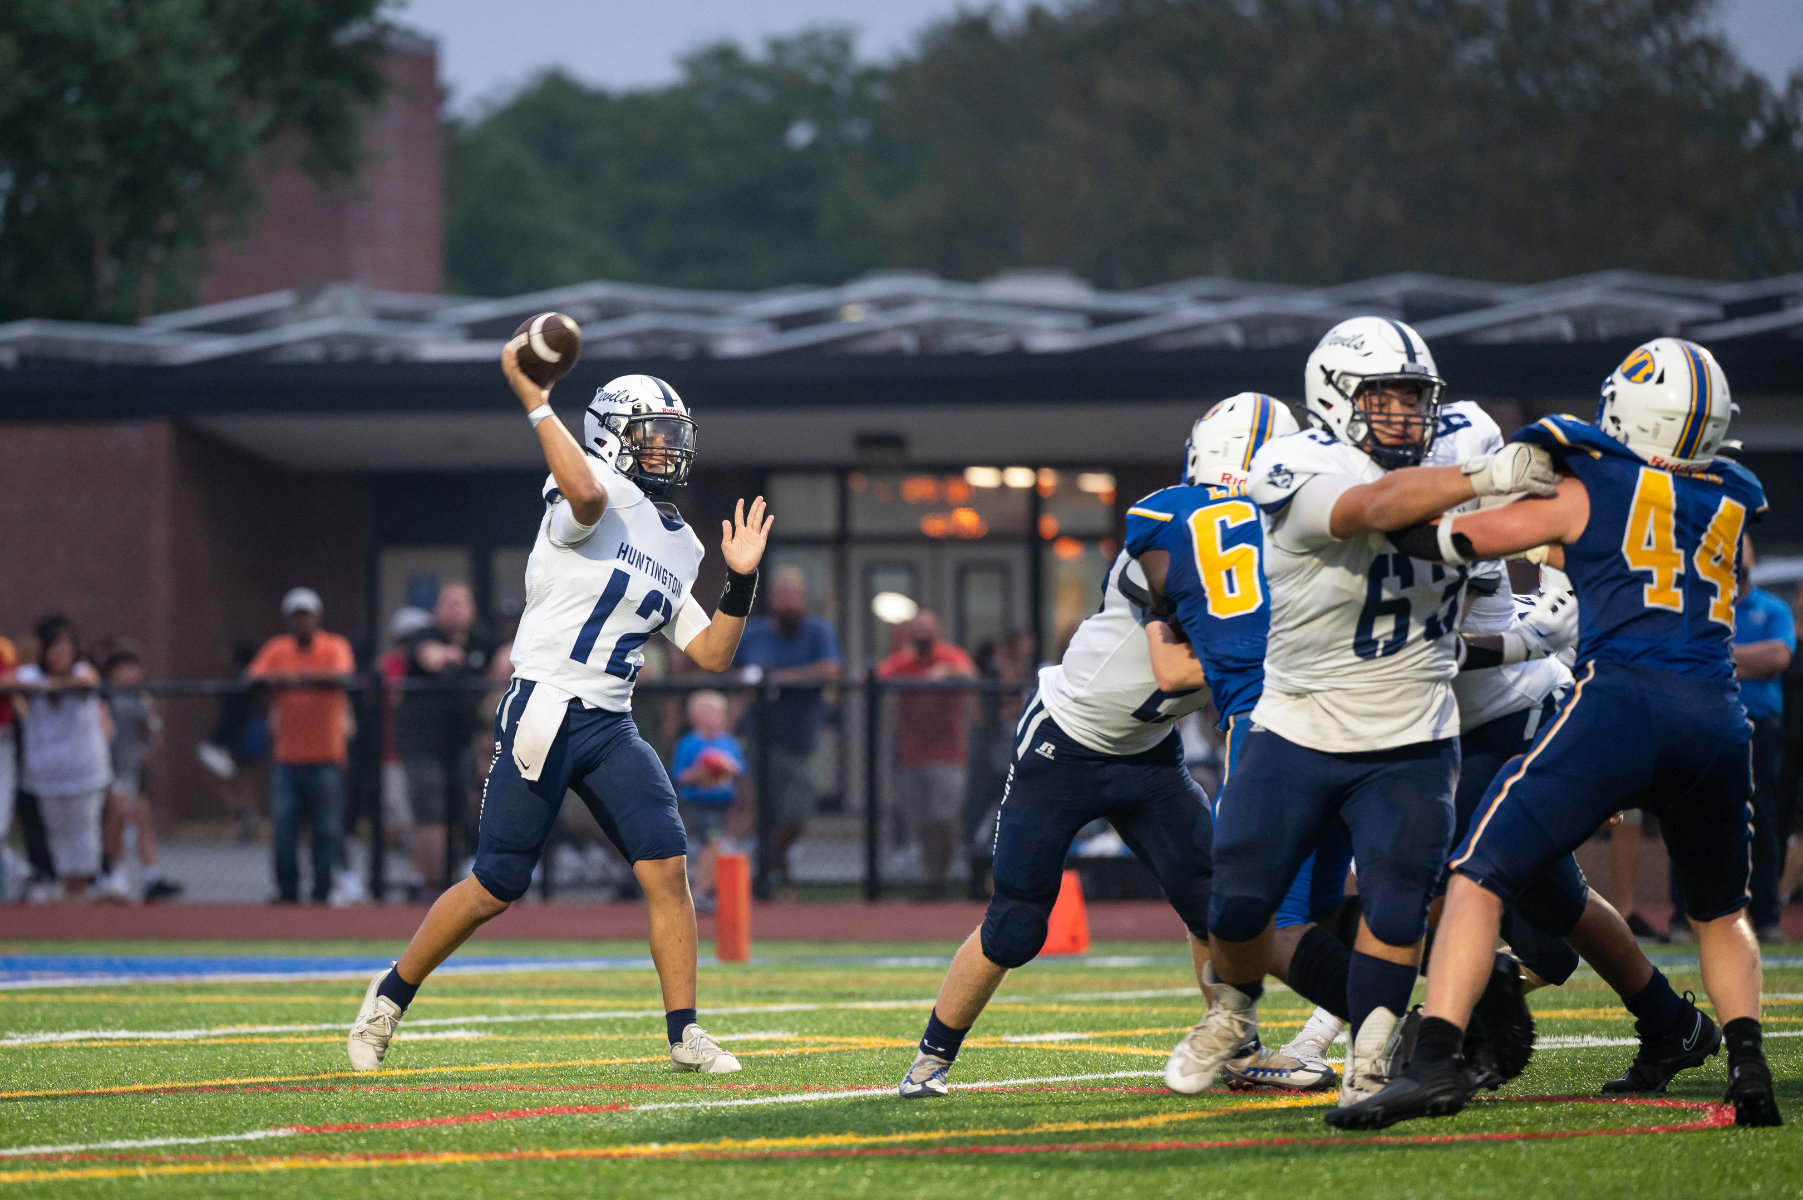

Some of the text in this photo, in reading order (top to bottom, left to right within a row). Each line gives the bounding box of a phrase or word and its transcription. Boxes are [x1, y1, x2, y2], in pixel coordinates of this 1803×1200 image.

[616, 541, 683, 599] HUNTINGTON
[1622, 466, 1747, 632] 44
[569, 567, 673, 683] 12
